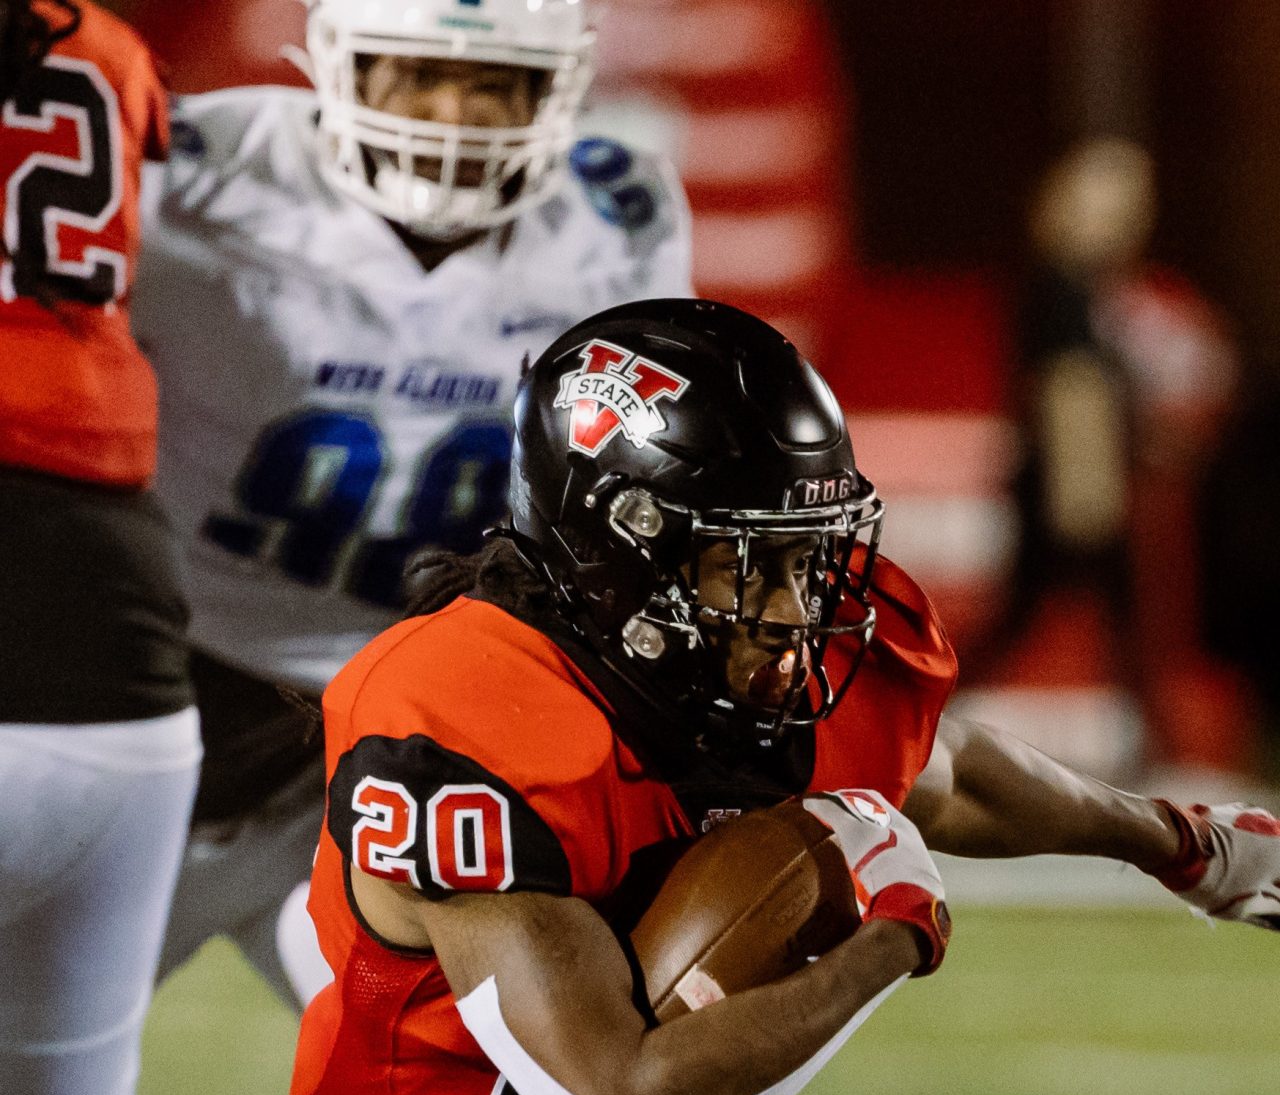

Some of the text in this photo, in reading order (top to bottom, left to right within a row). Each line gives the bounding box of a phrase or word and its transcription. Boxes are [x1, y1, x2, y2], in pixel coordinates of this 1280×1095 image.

[568, 338, 690, 458] V
[578, 378, 639, 418] STATE
[352, 775, 514, 892] 20
